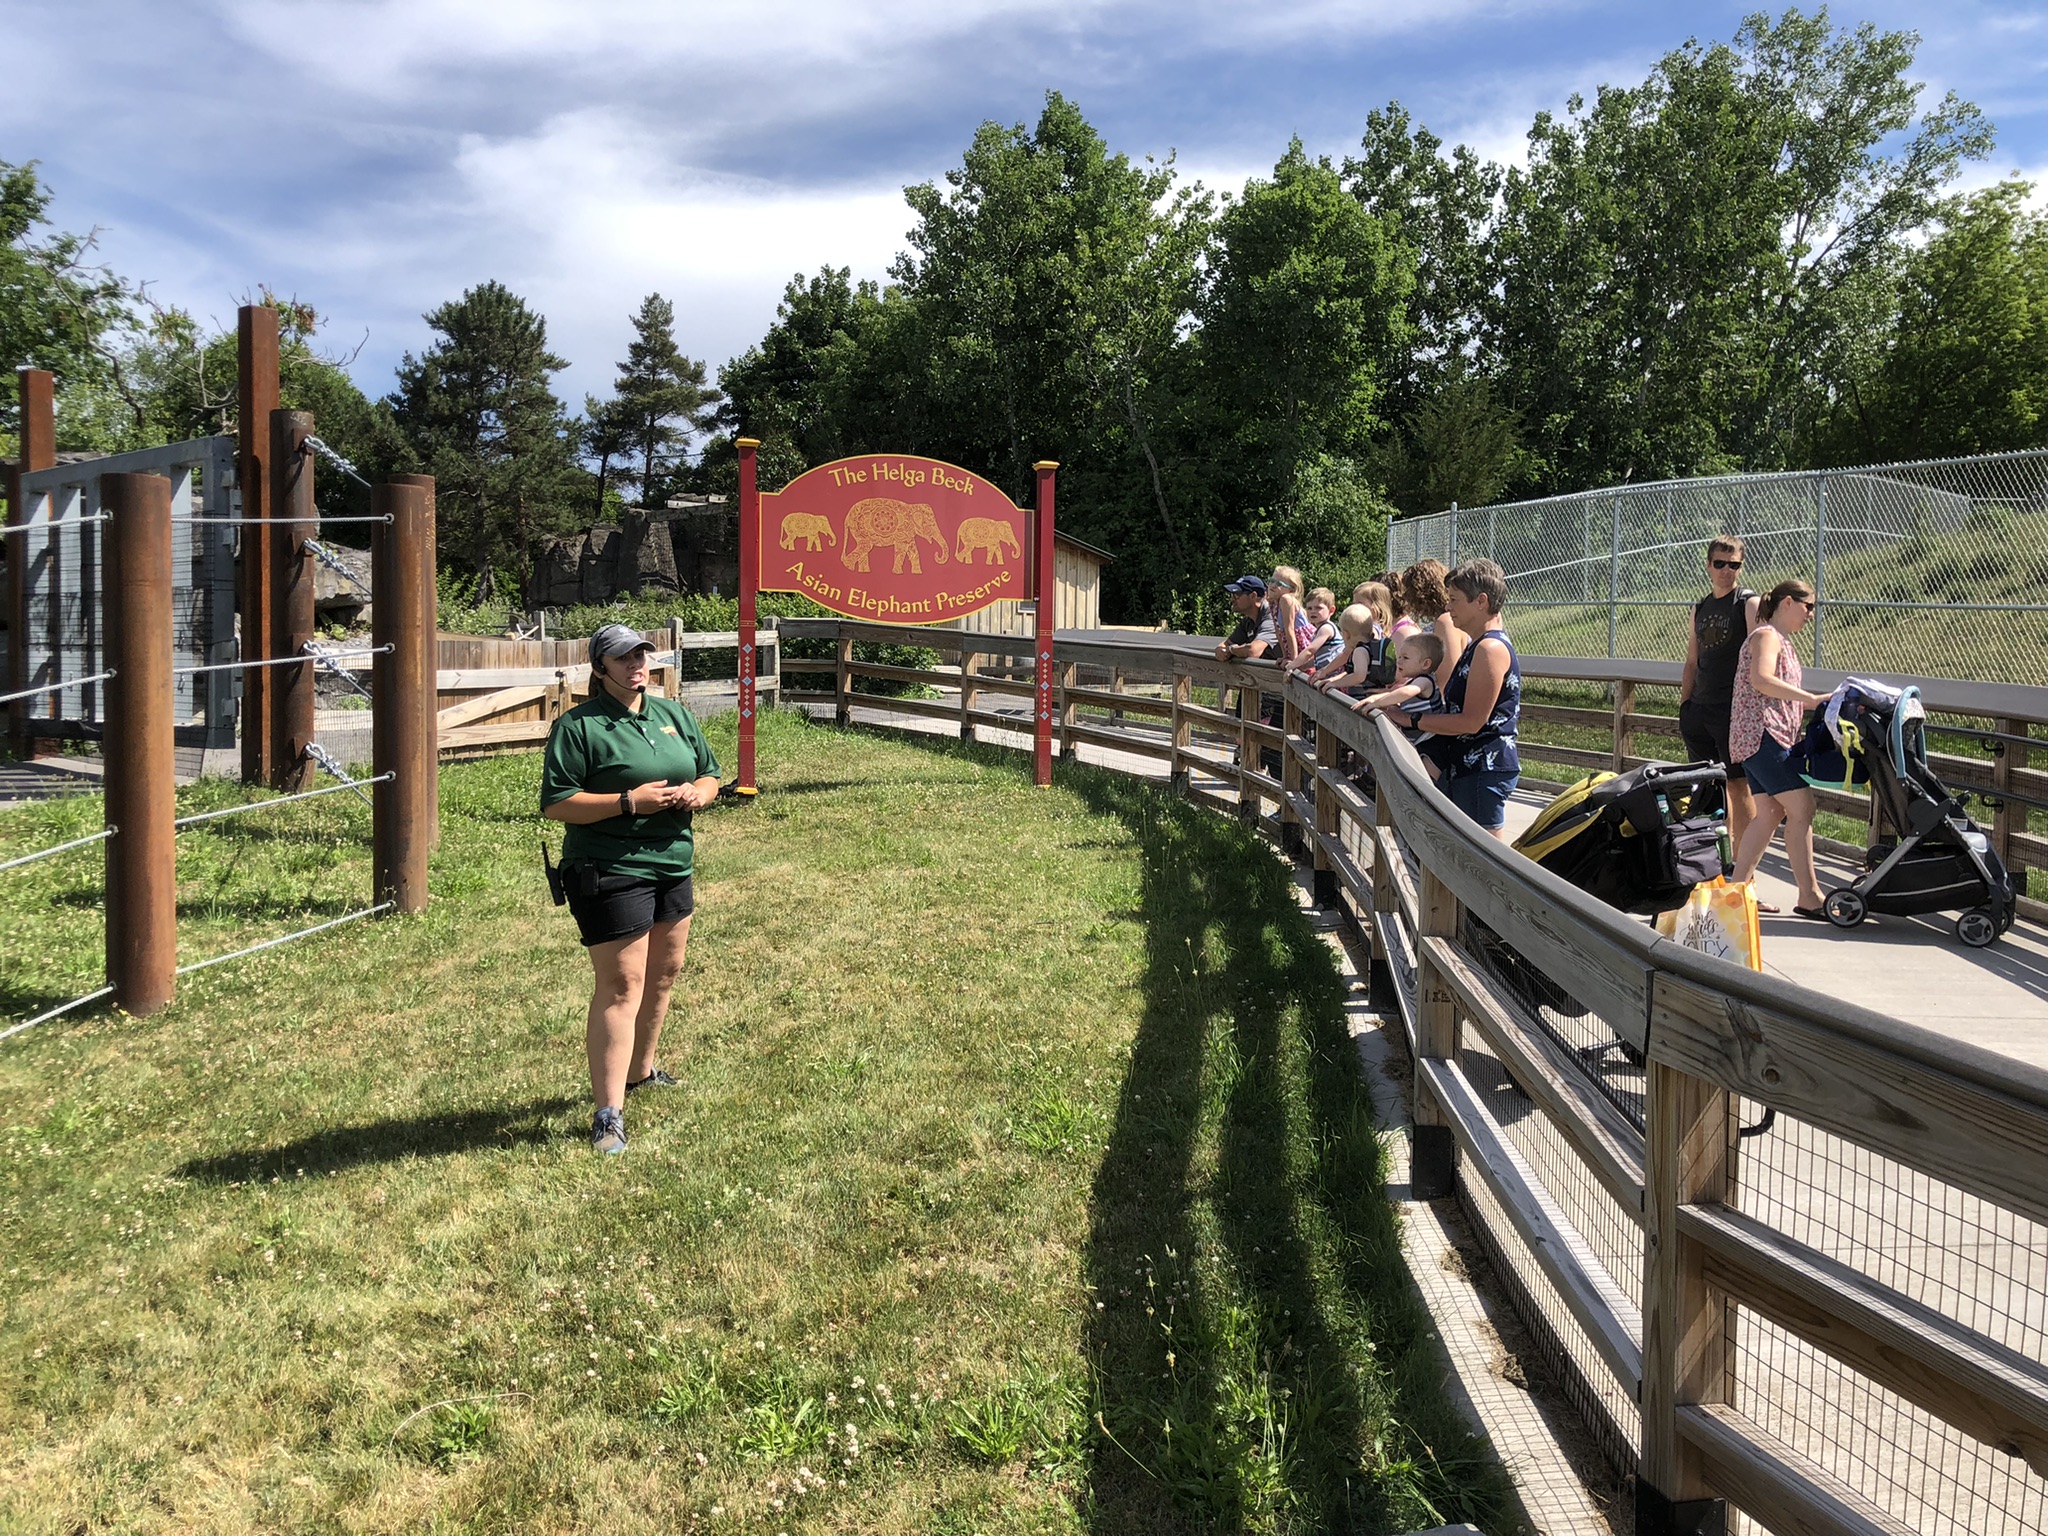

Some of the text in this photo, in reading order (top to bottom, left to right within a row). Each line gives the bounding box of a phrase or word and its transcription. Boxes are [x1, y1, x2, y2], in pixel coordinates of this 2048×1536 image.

[828, 462, 974, 496] The Helga Beck
[785, 561, 1012, 617] Asian Elephant Preserve
